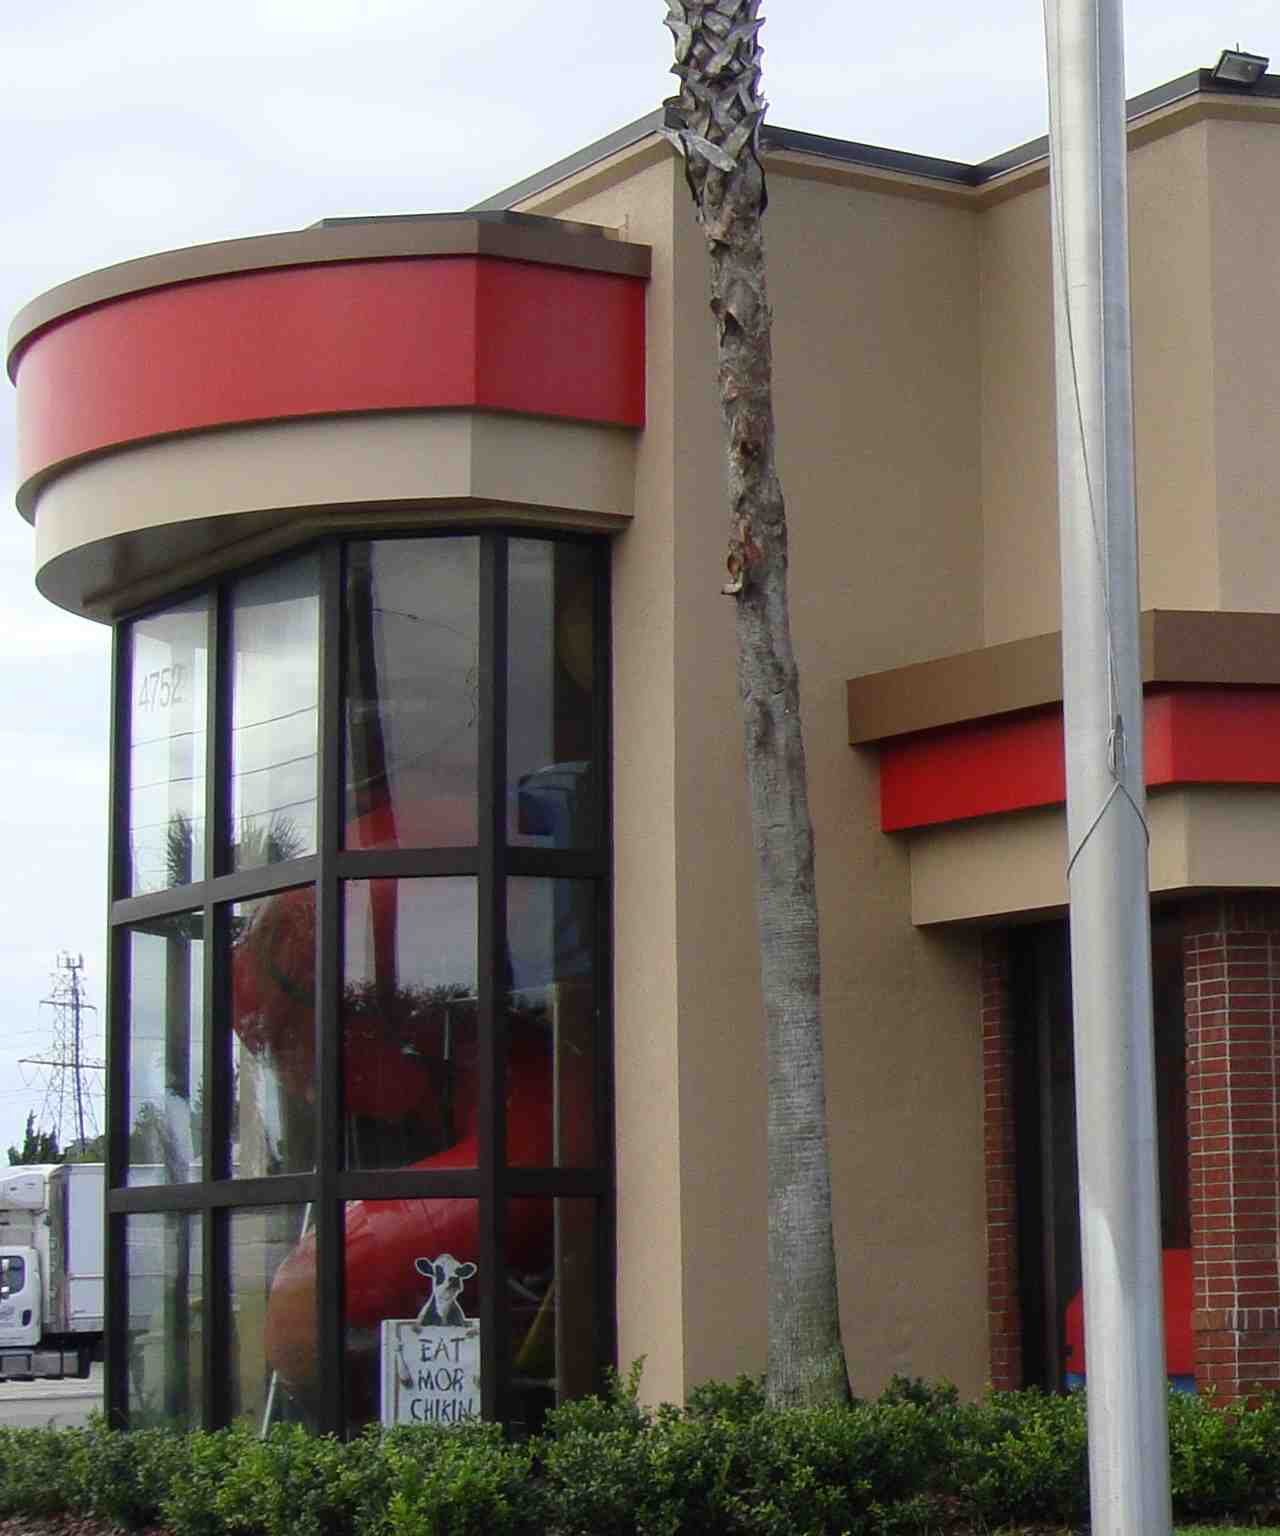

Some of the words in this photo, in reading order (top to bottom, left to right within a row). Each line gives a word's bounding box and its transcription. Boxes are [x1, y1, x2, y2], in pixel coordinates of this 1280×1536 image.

[139, 664, 186, 711] 4752
[419, 1338, 464, 1362] EAT
[418, 1368, 464, 1391] MOR
